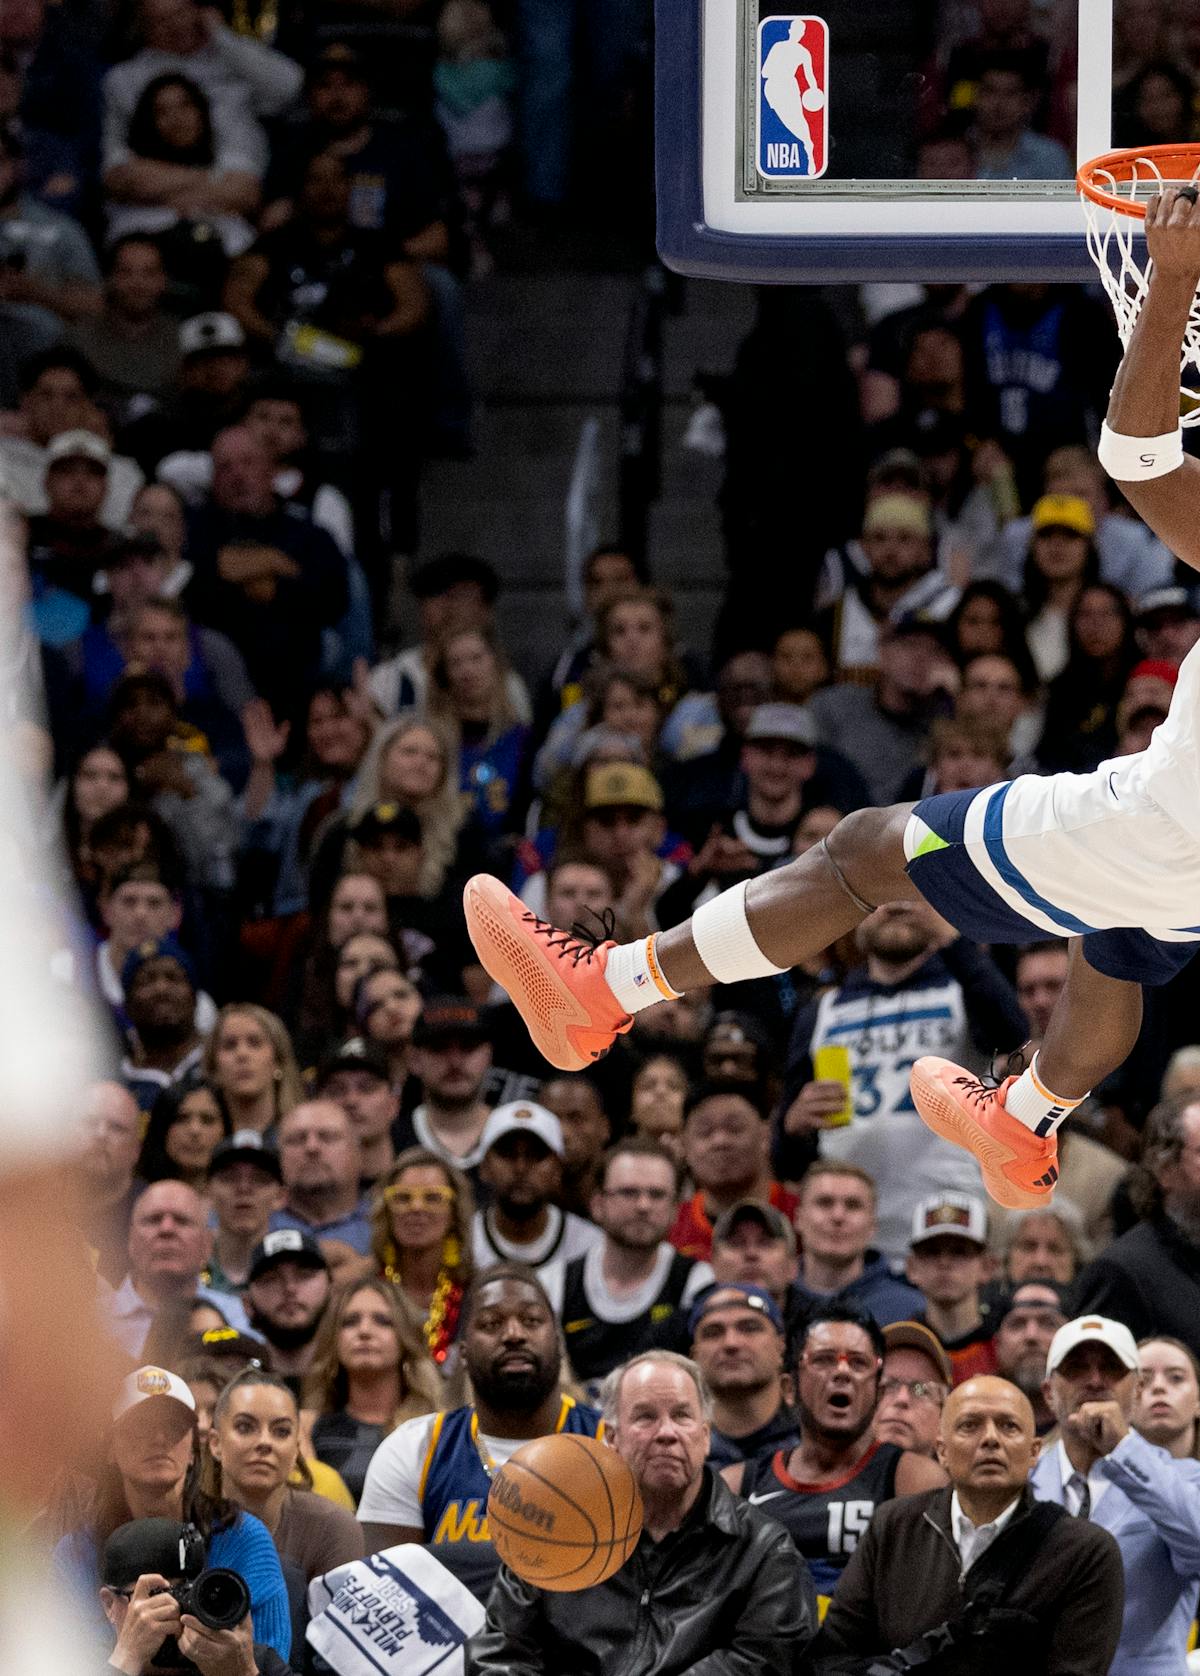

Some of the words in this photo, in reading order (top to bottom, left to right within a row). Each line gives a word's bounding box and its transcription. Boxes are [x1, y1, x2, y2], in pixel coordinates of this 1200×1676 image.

[767, 143, 800, 168] NBA
[827, 1500, 874, 1553] 15
[343, 1575, 414, 1641] PLAYOFFS
[362, 1621, 404, 1657] MILE
